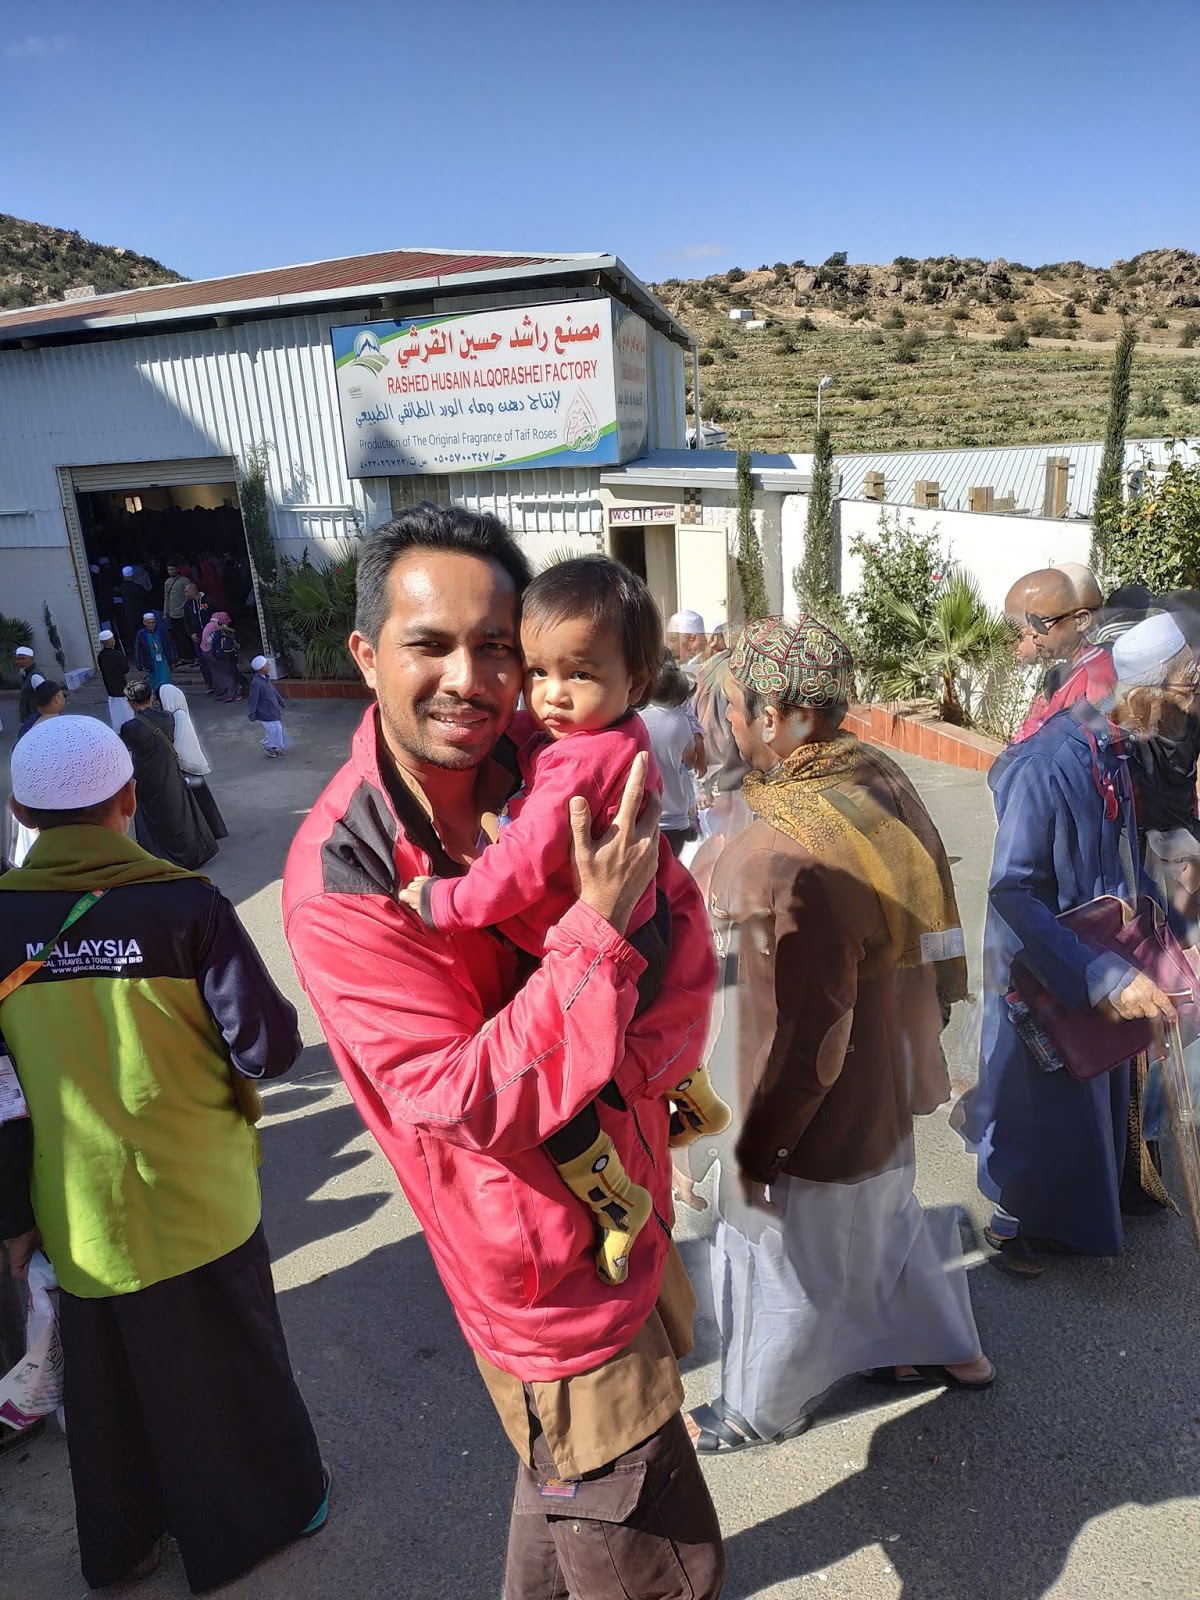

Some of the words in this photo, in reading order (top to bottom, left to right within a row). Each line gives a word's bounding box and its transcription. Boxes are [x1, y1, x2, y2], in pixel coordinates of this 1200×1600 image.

[459, 328, 503, 360] حسين
[509, 313, 549, 352] راشد
[554, 314, 600, 355] مصنع
[397, 325, 454, 369] القرشي
[387, 373, 429, 395] RASHED
[430, 370, 471, 392] HUSAIN
[473, 364, 544, 388] ALQORASHEI
[545, 359, 598, 382] FACTORY
[355, 402, 395, 429] الطبيعي
[398, 399, 435, 426] الطائفي
[440, 397, 464, 418] الورد
[498, 399, 525, 413] دهن
[359, 437, 401, 451] Production
[402, 435, 411, 448] of
[412, 434, 427, 447] The
[428, 431, 461, 449] Original
[461, 428, 504, 447] Fragrance
[504, 428, 514, 442] of
[514, 427, 531, 441] Taif
[532, 427, 558, 440] Roses
[26, 938, 142, 961] MALAYSIA
[58, 957, 84, 967] TRAVEL
[85, 957, 91, 965] &
[91, 957, 112, 965] TOURS
[113, 956, 128, 965] SDN
[128, 955, 143, 964] BHD
[51, 963, 122, 974] www.glocal.com.my
